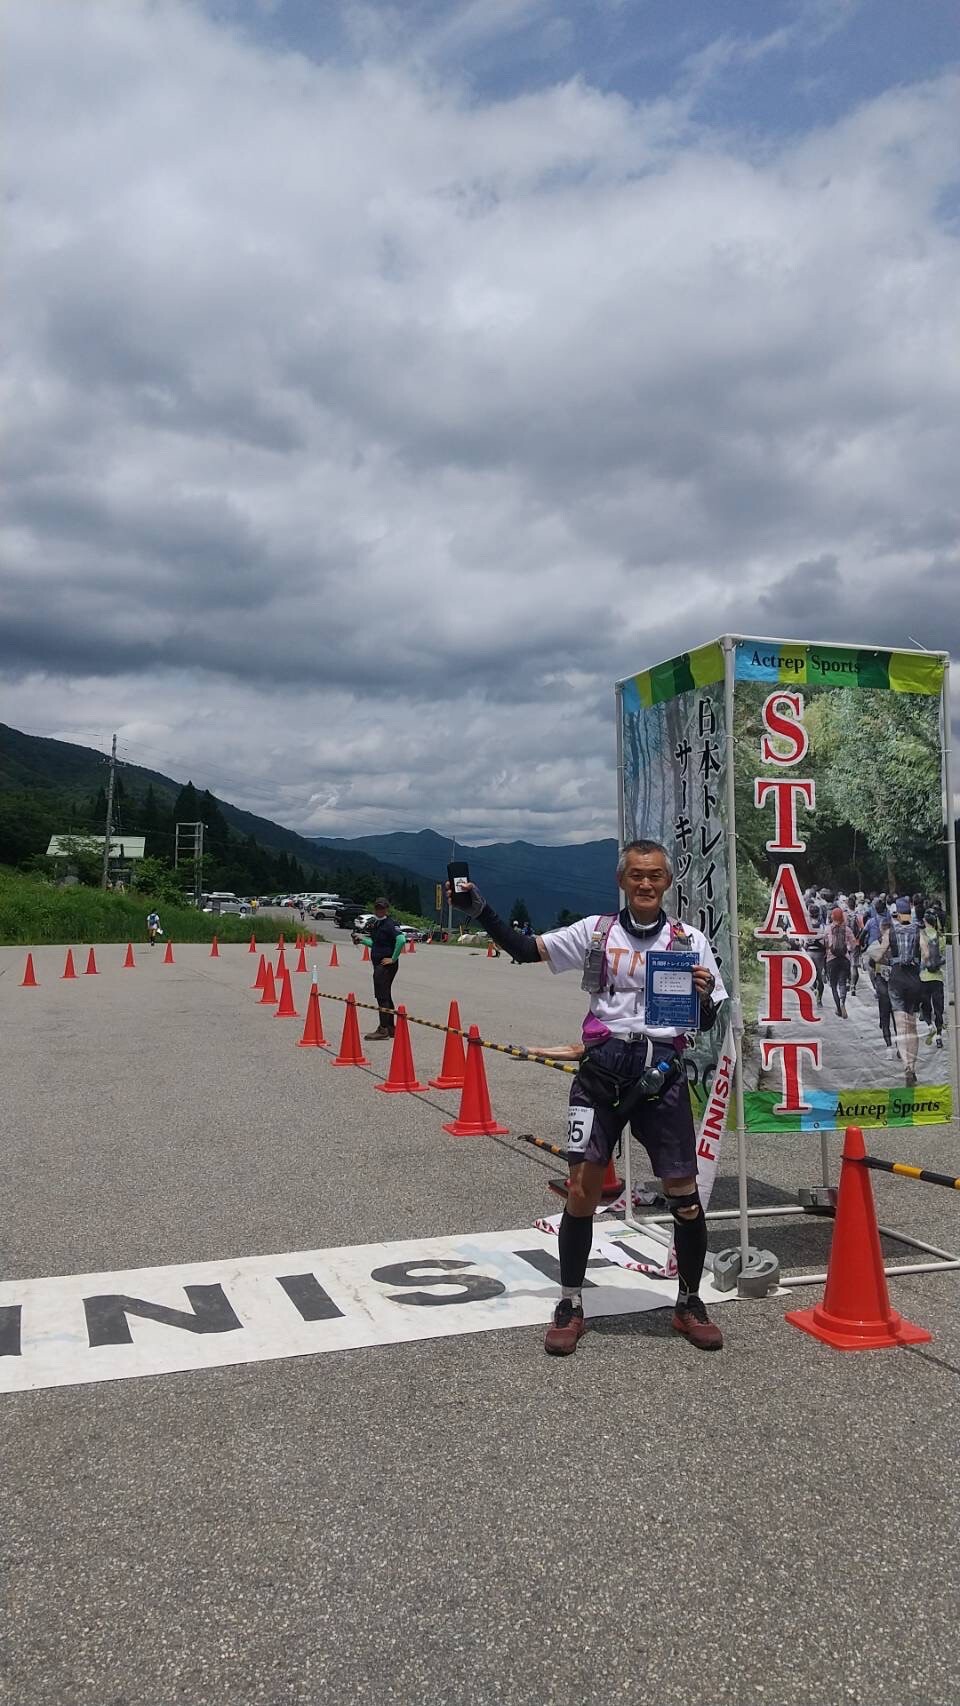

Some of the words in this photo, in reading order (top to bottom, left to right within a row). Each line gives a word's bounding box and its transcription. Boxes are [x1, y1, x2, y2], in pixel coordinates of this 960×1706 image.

[750, 651, 804, 673] Actrep
[811, 655, 861, 675] Sports
[674, 738, 693, 920] サーキット
[754, 691, 823, 1114] START
[696, 1055, 732, 1161] FINISH
[833, 1101, 886, 1119] Actrep
[892, 1098, 941, 1118] Sports
